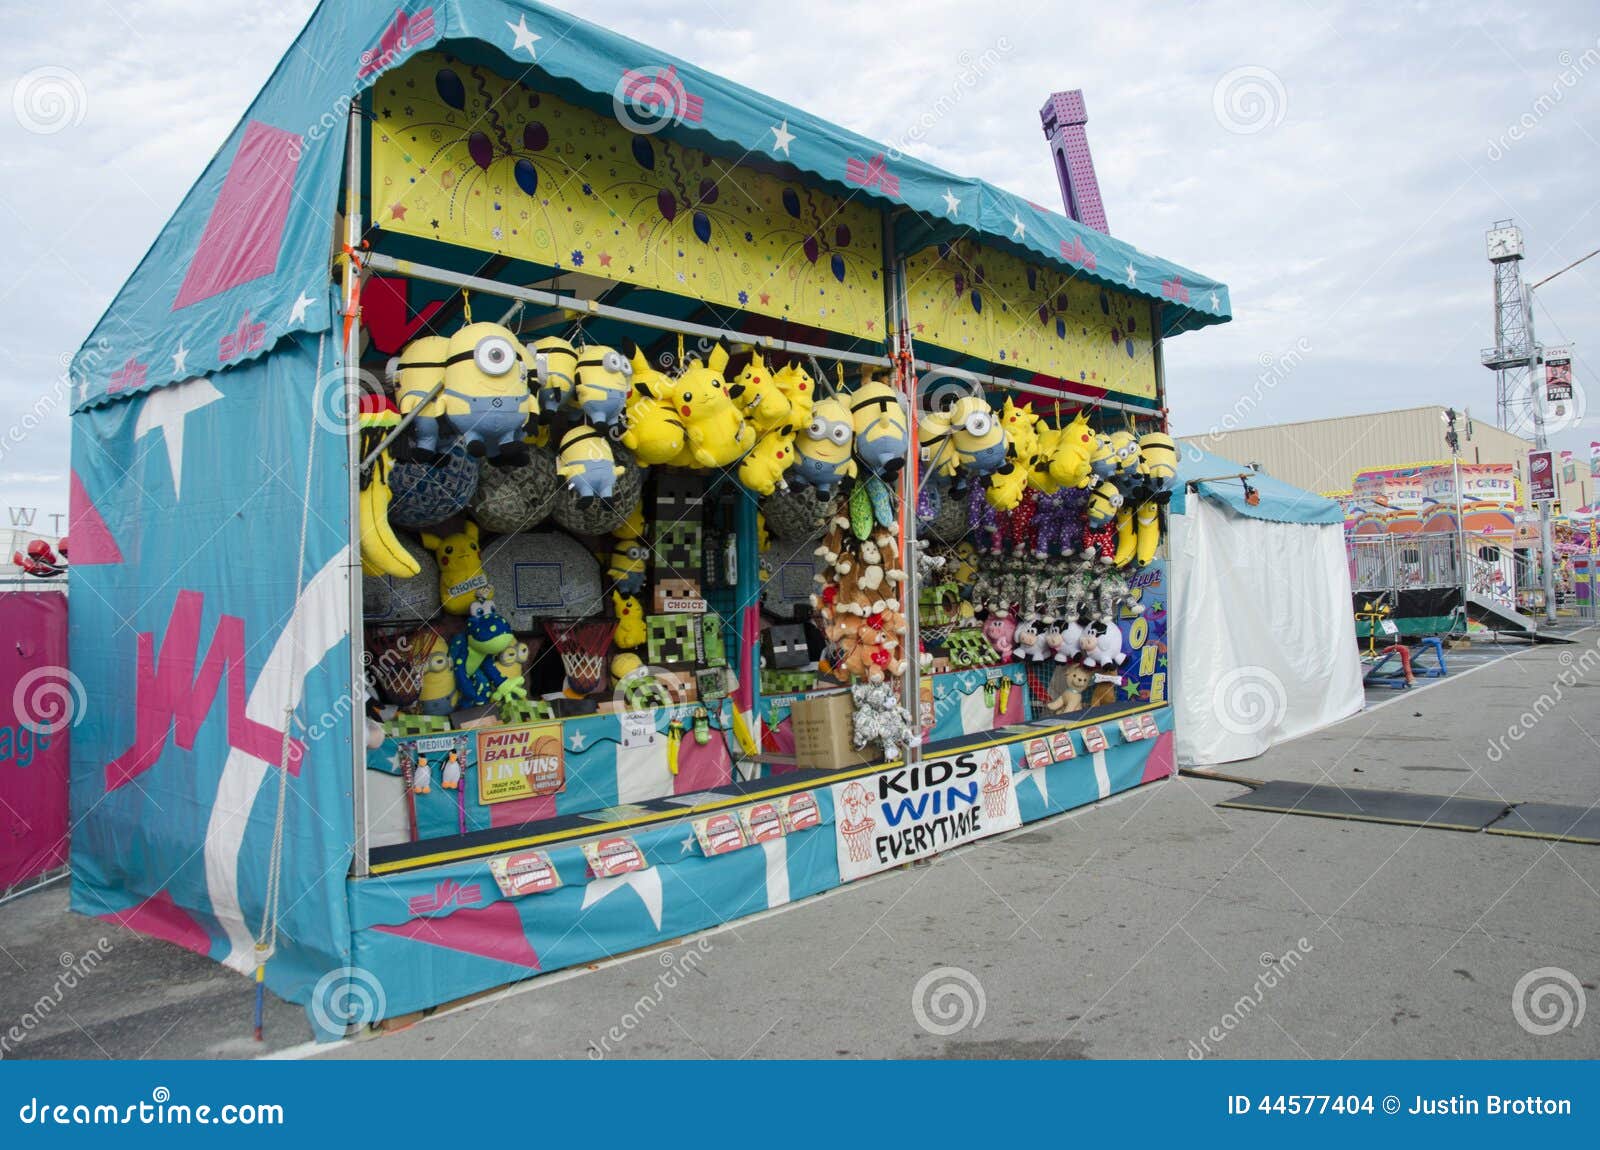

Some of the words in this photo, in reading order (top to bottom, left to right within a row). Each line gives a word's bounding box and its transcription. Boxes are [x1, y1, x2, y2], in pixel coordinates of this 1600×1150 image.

[1465, 479, 1509, 489] TCKETS
[667, 601, 704, 609] CHOICE
[418, 740, 452, 750] MEDIUM
[487, 732, 530, 747] MINI
[484, 746, 532, 762] BALL
[520, 756, 559, 776] WINS
[879, 753, 978, 800] KIDS
[881, 781, 979, 827] WIN
[876, 805, 981, 864] EVERYTIME
